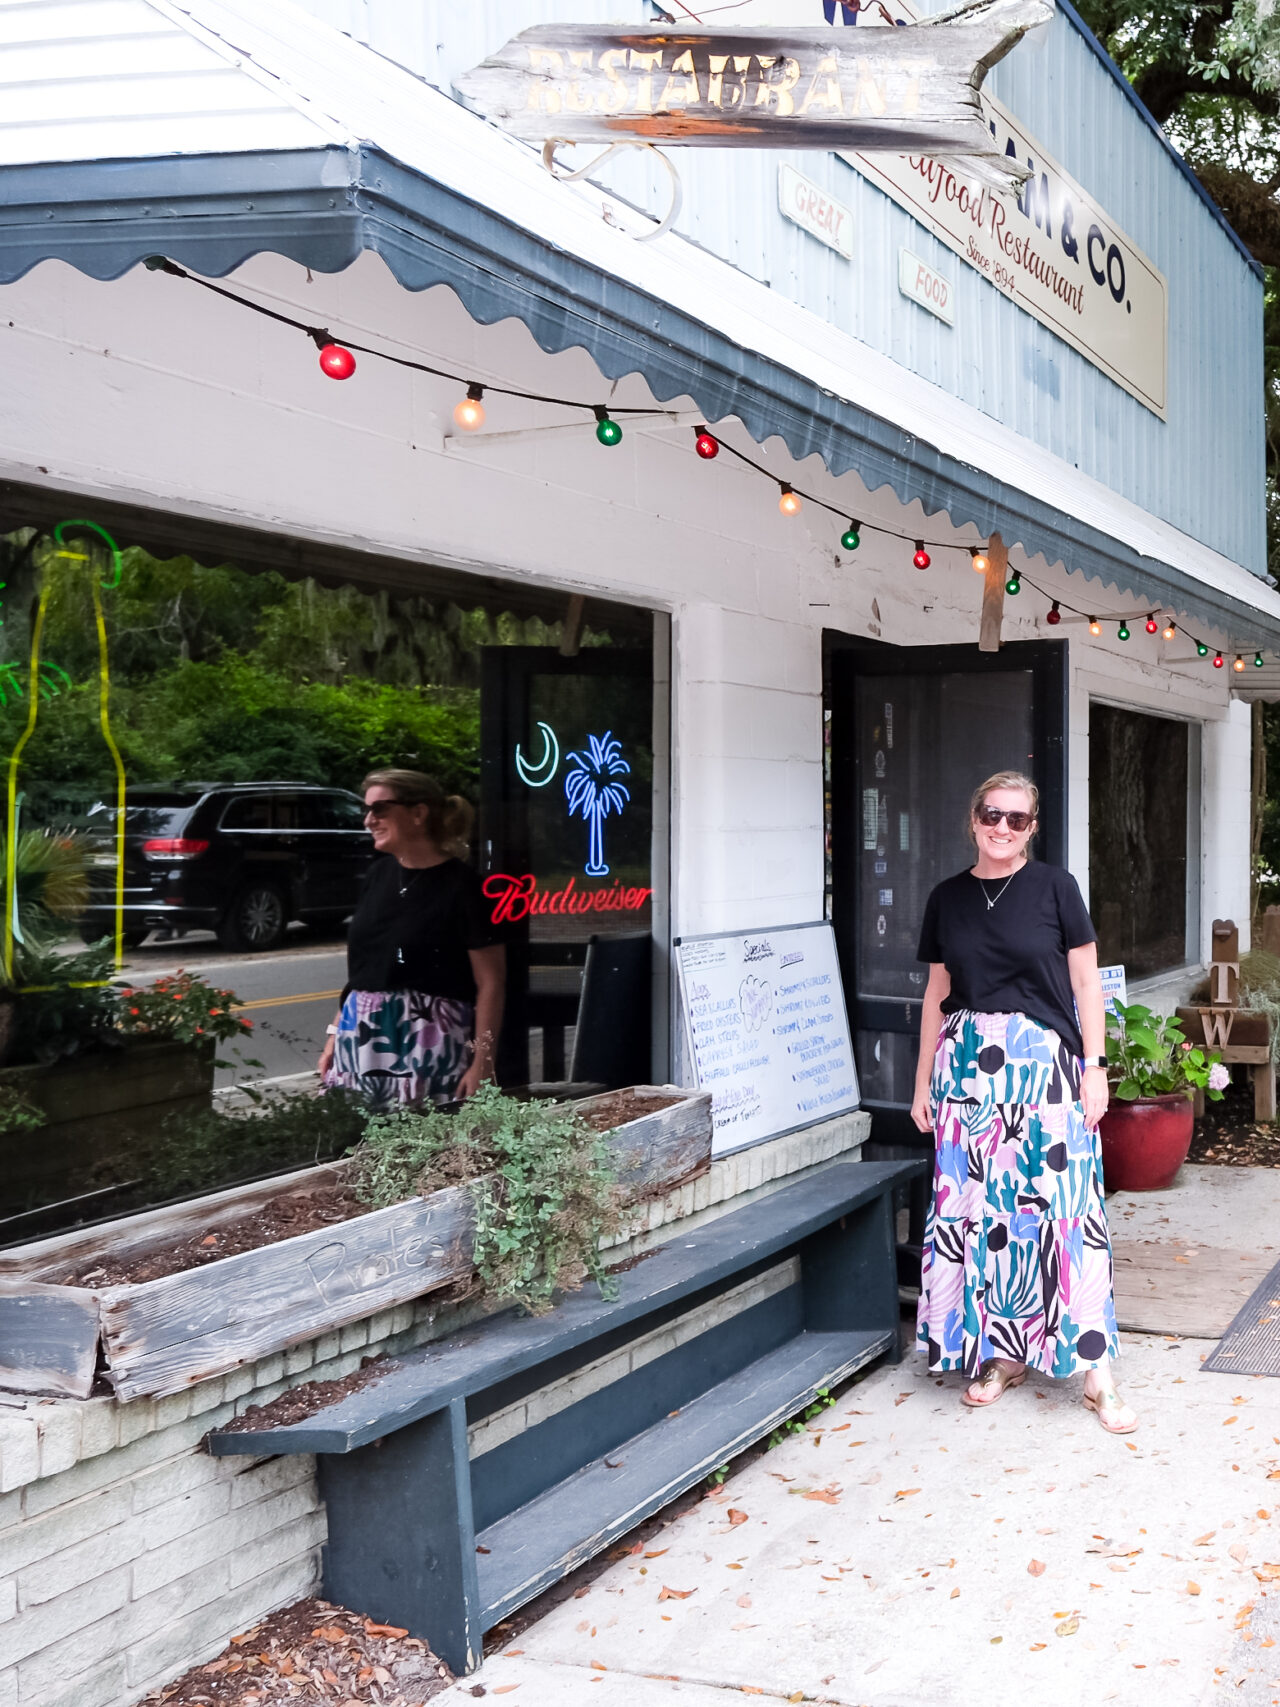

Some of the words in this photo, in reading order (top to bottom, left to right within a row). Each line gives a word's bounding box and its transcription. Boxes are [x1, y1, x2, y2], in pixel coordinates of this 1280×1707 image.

[527, 47, 935, 117] RESTAURANT
[795, 181, 844, 238] GREAT
[966, 235, 991, 272] Since
[988, 194, 1085, 315] Restaurant
[1087, 223, 1132, 314] CO.
[915, 264, 949, 309] FOOD
[482, 874, 655, 924] Budweiser
[1207, 961, 1240, 1004] T
[1199, 1008, 1234, 1050] W
